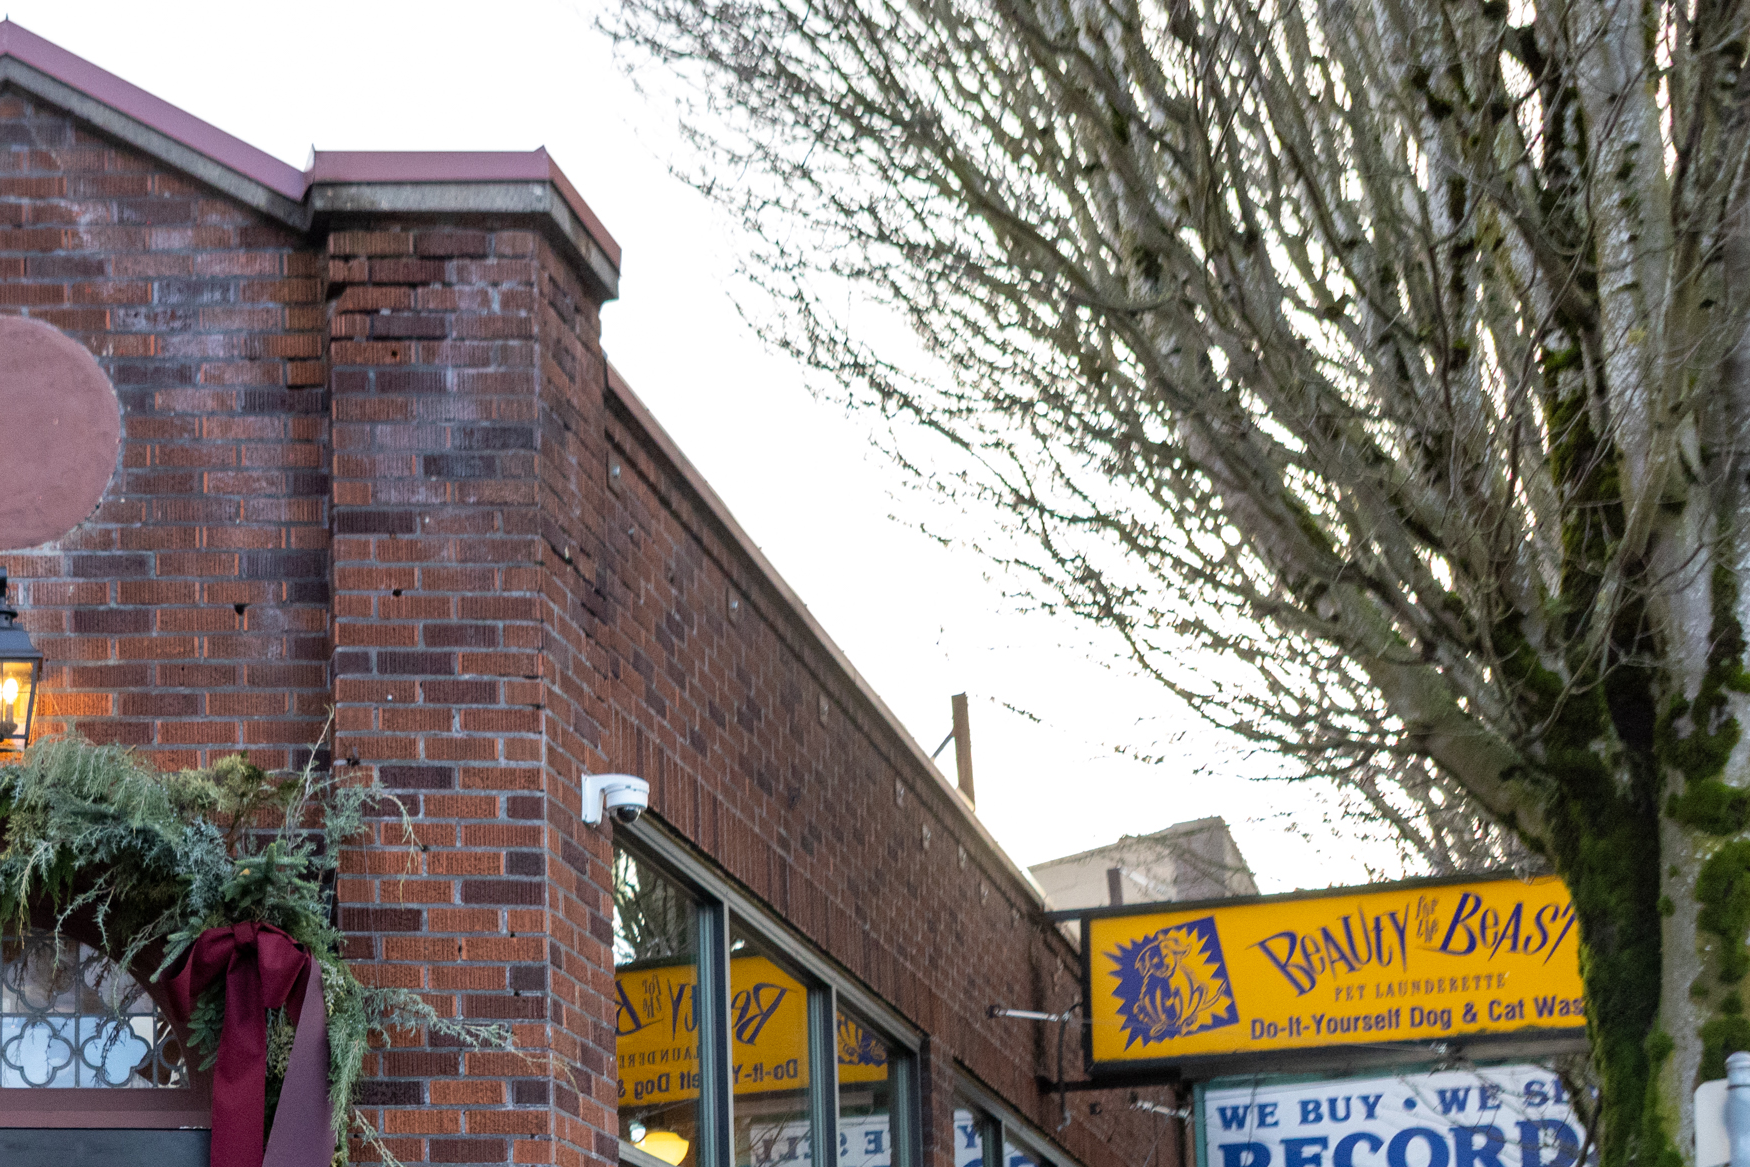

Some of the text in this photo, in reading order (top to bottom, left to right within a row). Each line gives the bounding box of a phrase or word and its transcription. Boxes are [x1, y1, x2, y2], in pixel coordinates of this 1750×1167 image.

[1334, 972, 1507, 1003] PET LAUNDERETTE
[1251, 994, 1584, 1040] Do-It-Yourself Dog & Cat Was
[1217, 1102, 1279, 1131] WE
[1298, 1094, 1383, 1125] BUY
[1437, 1084, 1502, 1115] WE
